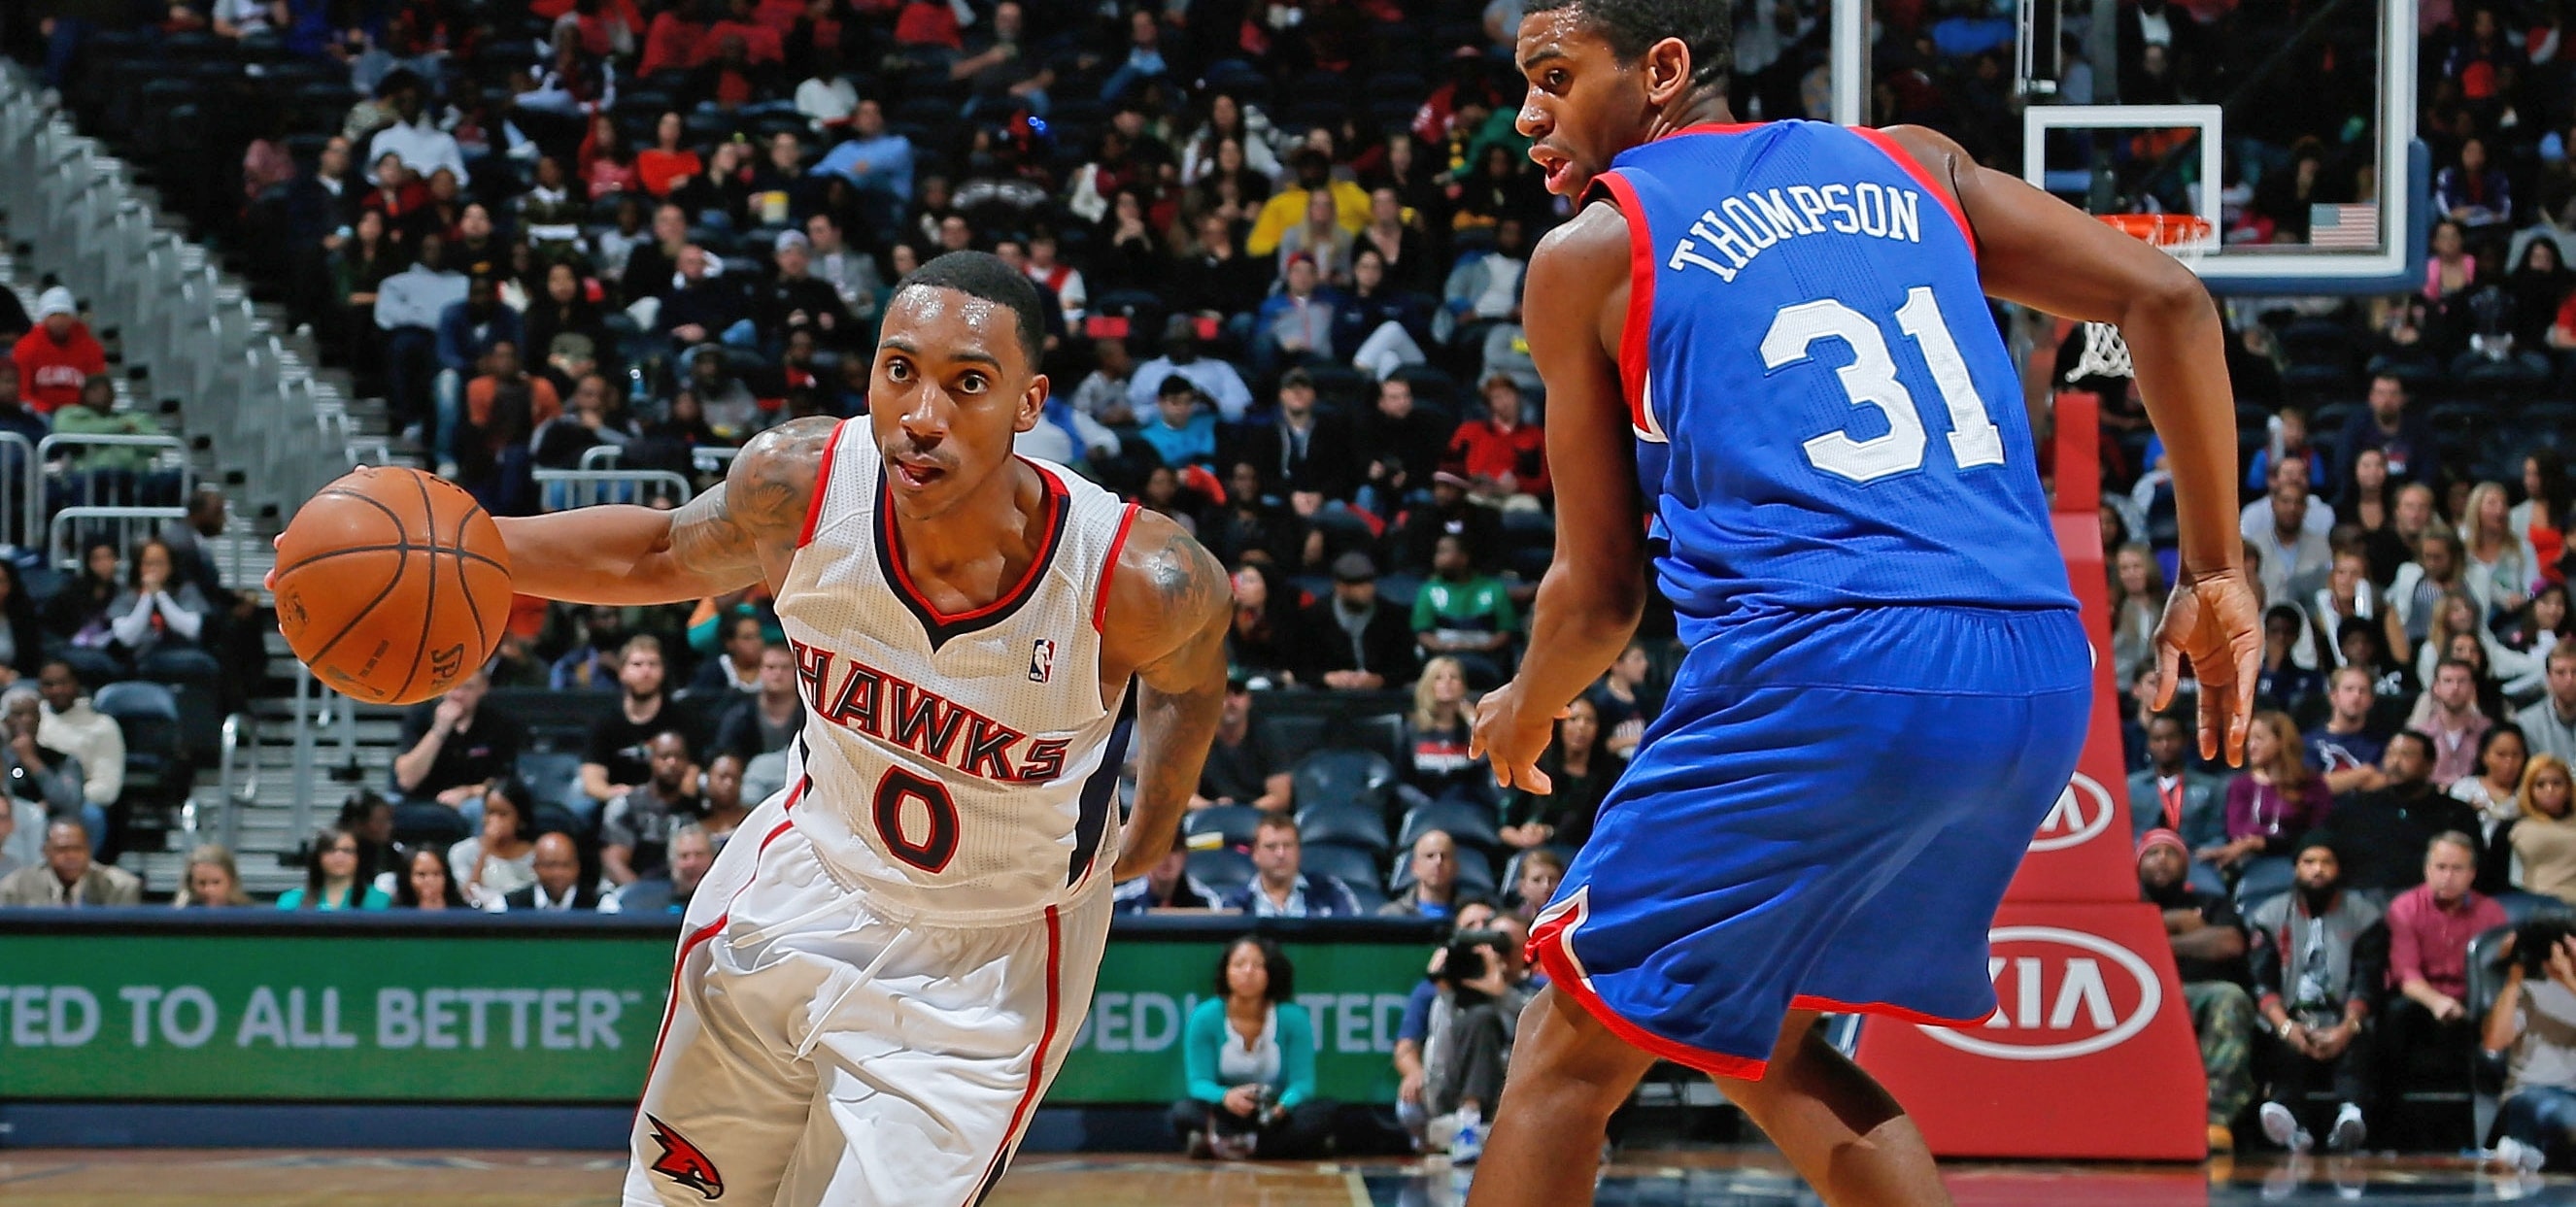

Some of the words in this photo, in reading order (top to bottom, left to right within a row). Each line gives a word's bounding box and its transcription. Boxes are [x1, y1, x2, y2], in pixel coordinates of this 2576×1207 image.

[1668, 182, 1920, 283] THOMPSON
[1759, 285, 2006, 484] 31
[789, 637, 1072, 785] HAWKS
[872, 764, 961, 874] 0
[119, 985, 219, 1048] TO
[236, 986, 358, 1049] ALL
[376, 988, 623, 1050] BETTER
